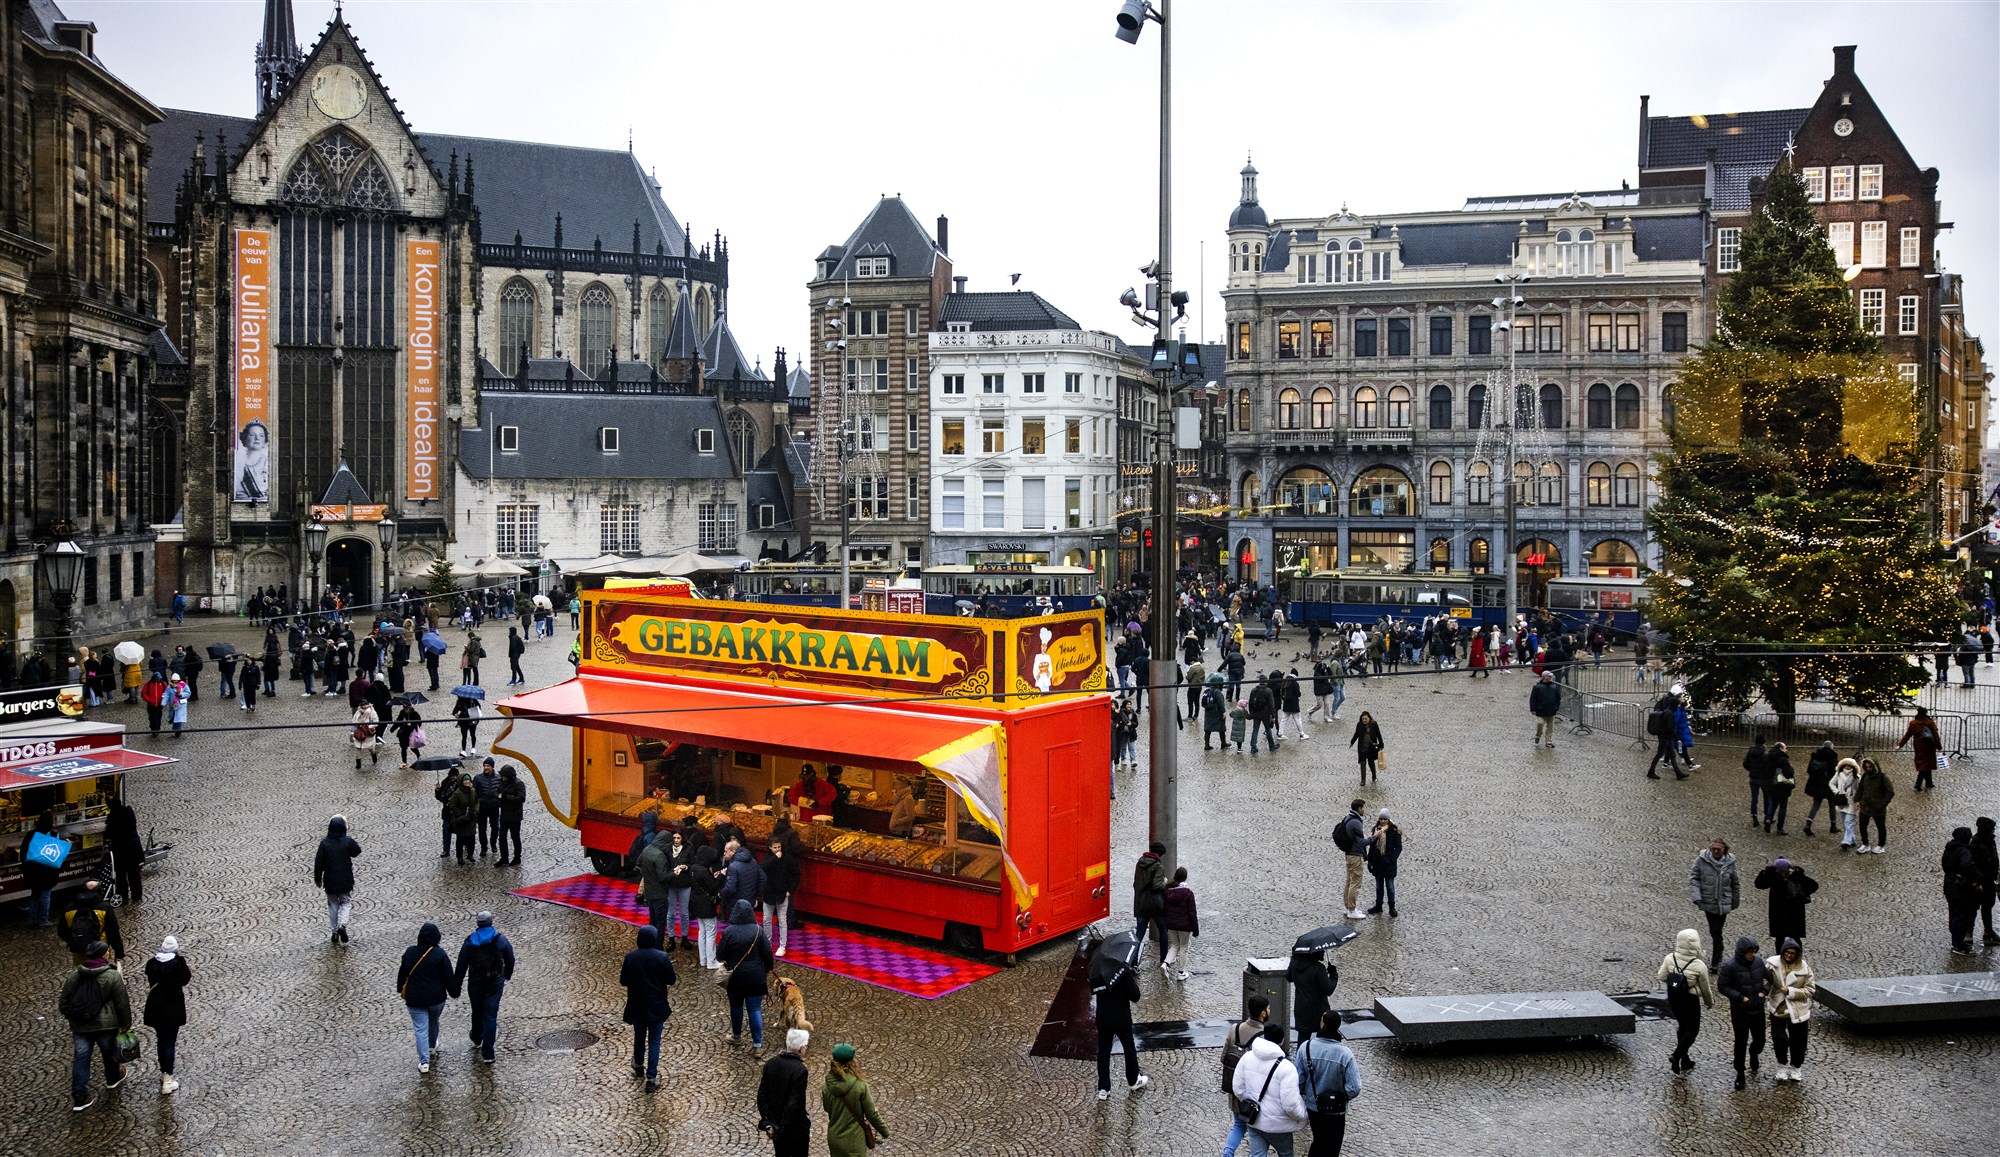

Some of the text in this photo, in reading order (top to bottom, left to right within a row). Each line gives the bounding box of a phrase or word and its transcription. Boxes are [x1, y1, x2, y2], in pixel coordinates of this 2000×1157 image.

[247, 237, 260, 247] De
[241, 247, 267, 256] eeuw
[415, 247, 432, 256] Een
[245, 256, 262, 264] van
[410, 263, 438, 370] koningin
[241, 274, 267, 370] Juliana
[418, 377, 430, 385] en
[414, 384, 433, 393] haar
[414, 401, 437, 493] idealen
[1526, 553, 1546, 565] H&M
[639, 619, 931, 677] GEBAKKRAAM
[1055, 652, 1091, 672] Oliebollen
[74, 744, 91, 752] MORE
